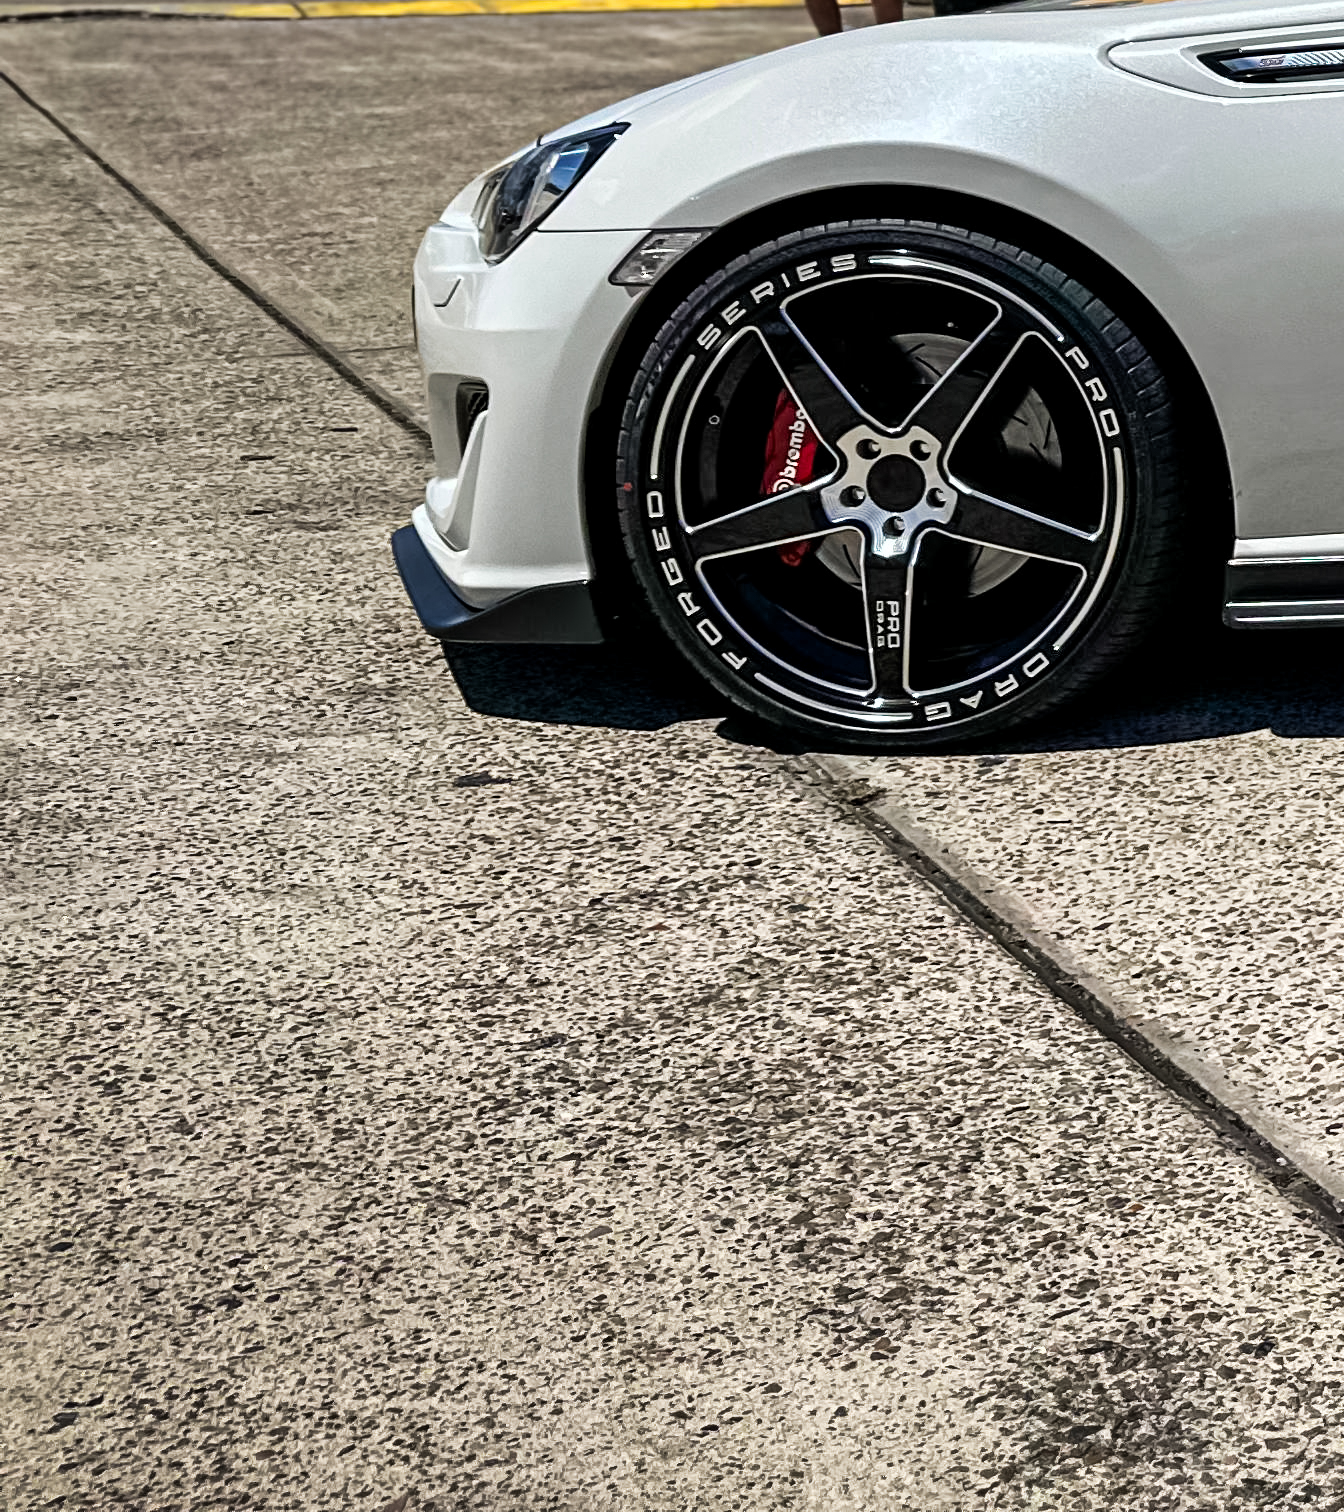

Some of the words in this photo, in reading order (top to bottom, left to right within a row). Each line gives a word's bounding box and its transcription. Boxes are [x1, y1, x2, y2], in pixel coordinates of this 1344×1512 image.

[696, 254, 858, 352] SERIES
[1064, 345, 1121, 438] PRO
[778, 408, 807, 480] brembo
[646, 490, 749, 672] FORGED
[886, 600, 900, 649] PRO
[924, 653, 1050, 723] DRAG
